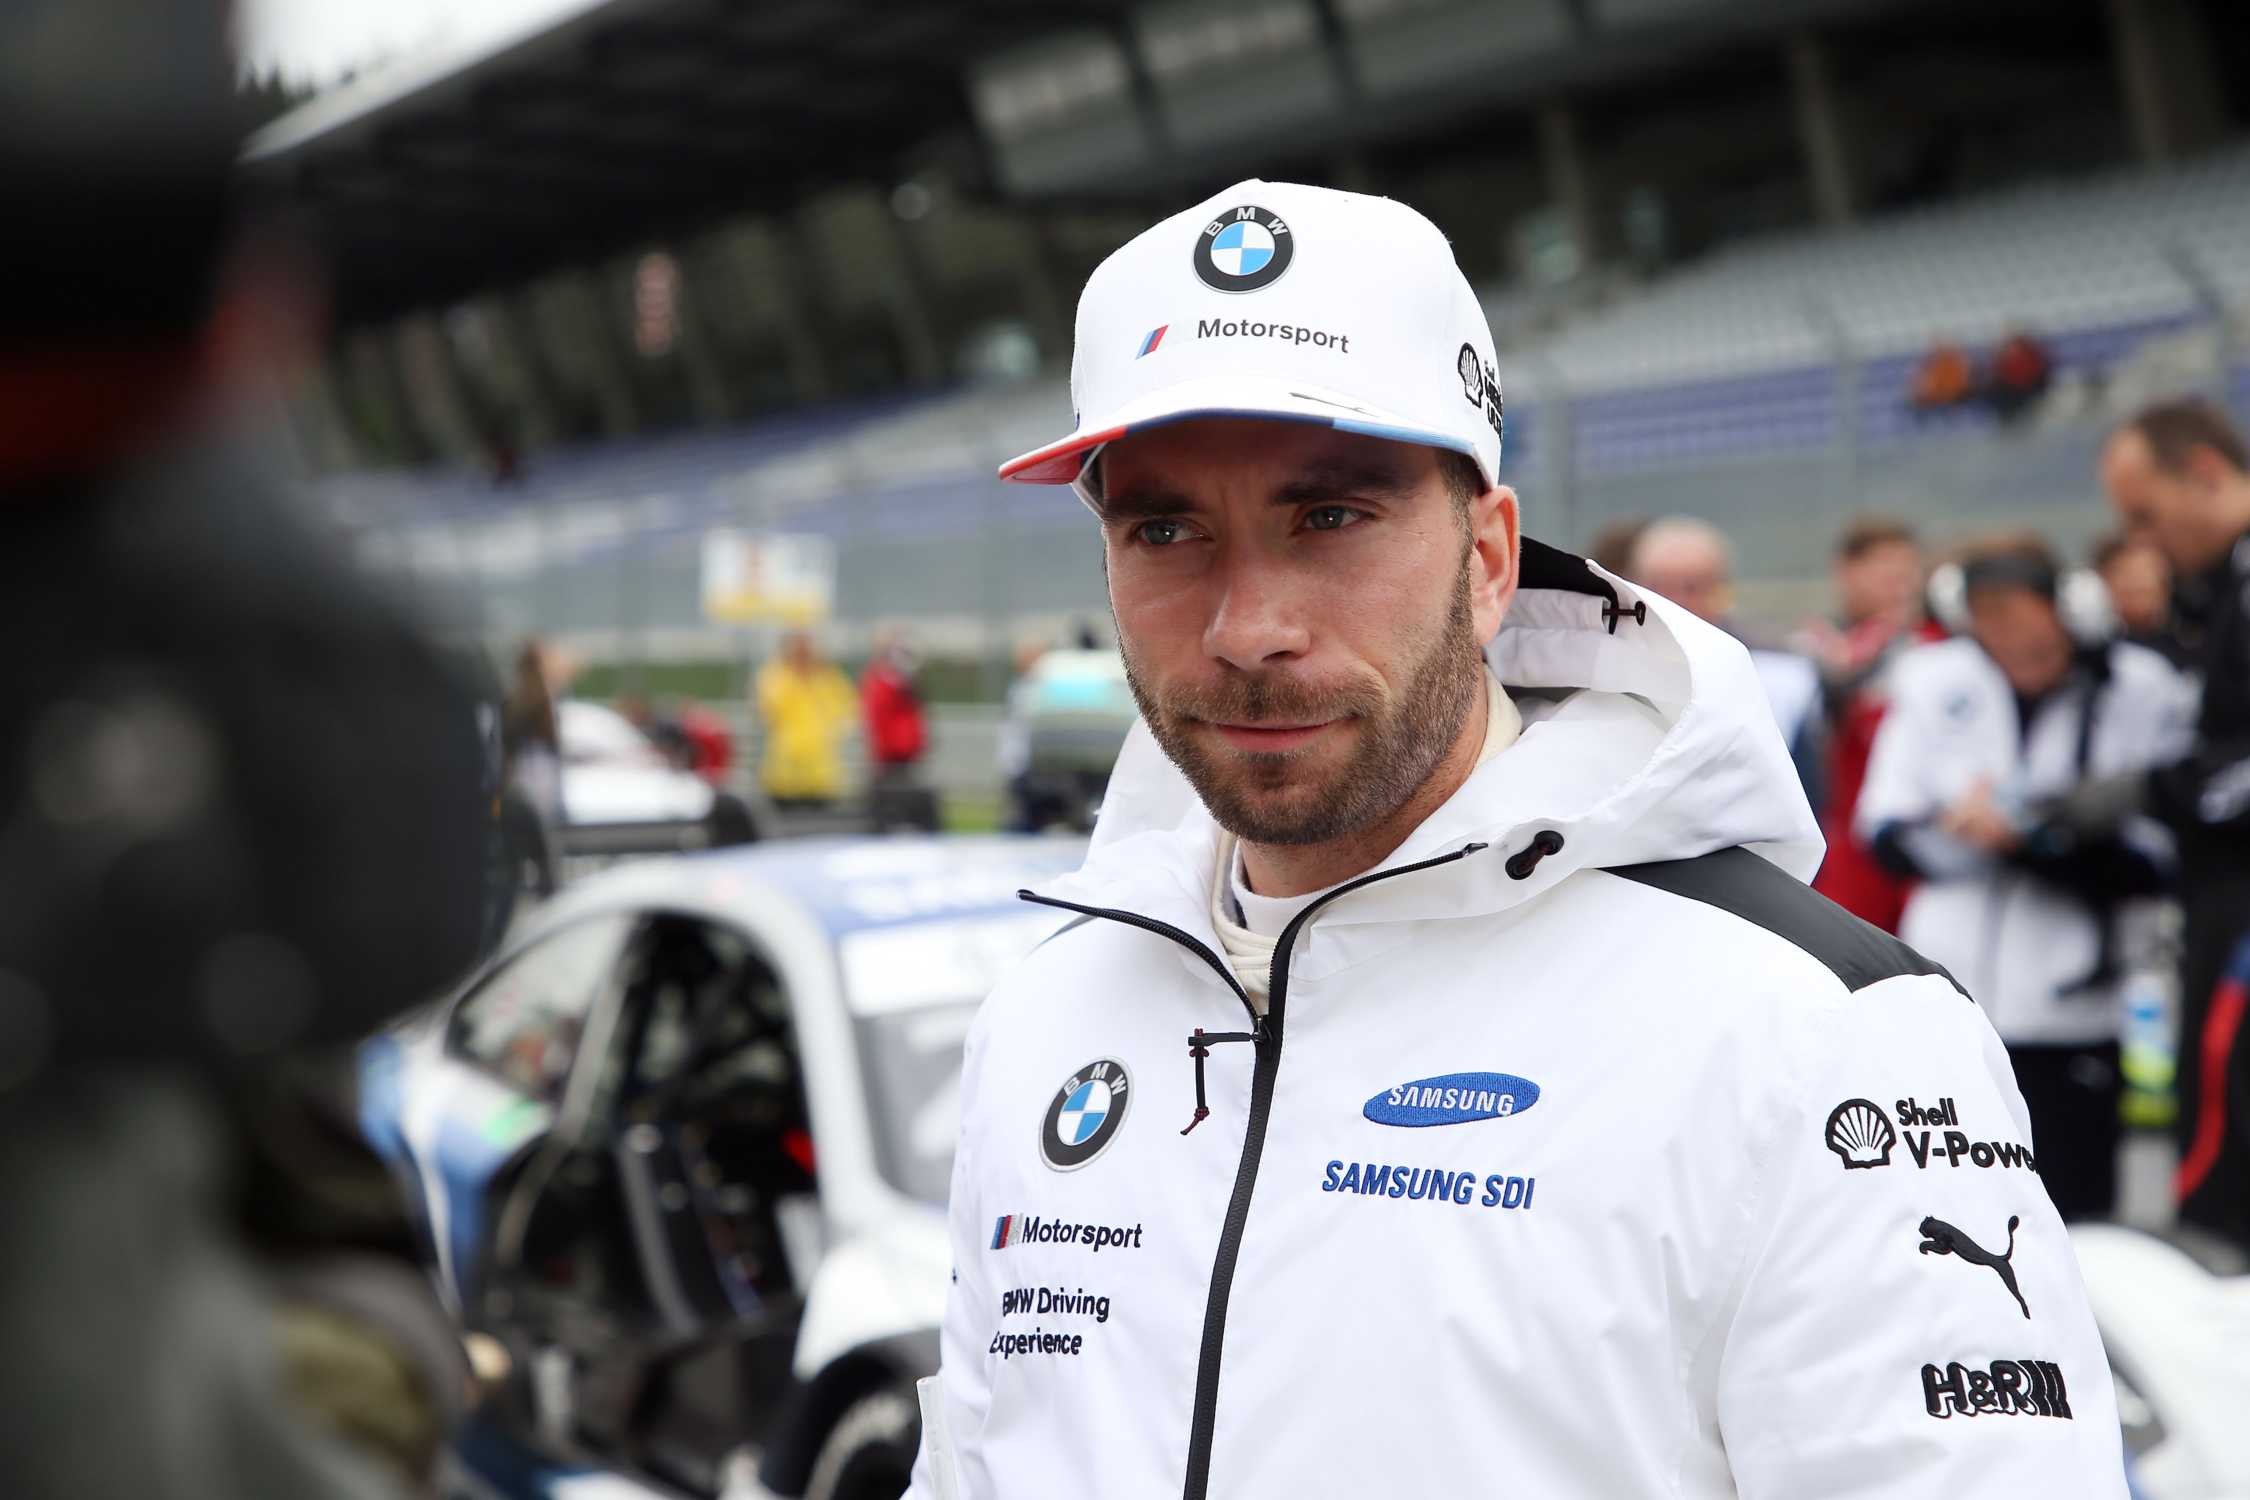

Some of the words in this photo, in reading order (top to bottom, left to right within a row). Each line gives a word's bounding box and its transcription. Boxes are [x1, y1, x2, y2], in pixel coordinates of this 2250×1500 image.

[1204, 206, 1289, 237] BMW
[1198, 318, 1349, 353] Motorsport
[1063, 1063, 1128, 1096] BMW
[1387, 1085, 1515, 1116] SAMSUNG
[1896, 1098, 1958, 1126] Shell
[1322, 1160, 1476, 1205] SAMSUNG
[1482, 1174, 1535, 1209] SDI
[1022, 1217, 1143, 1252] Motorsport
[1037, 1287, 1110, 1323] Driving
[1921, 1360, 2038, 1418] H&R
